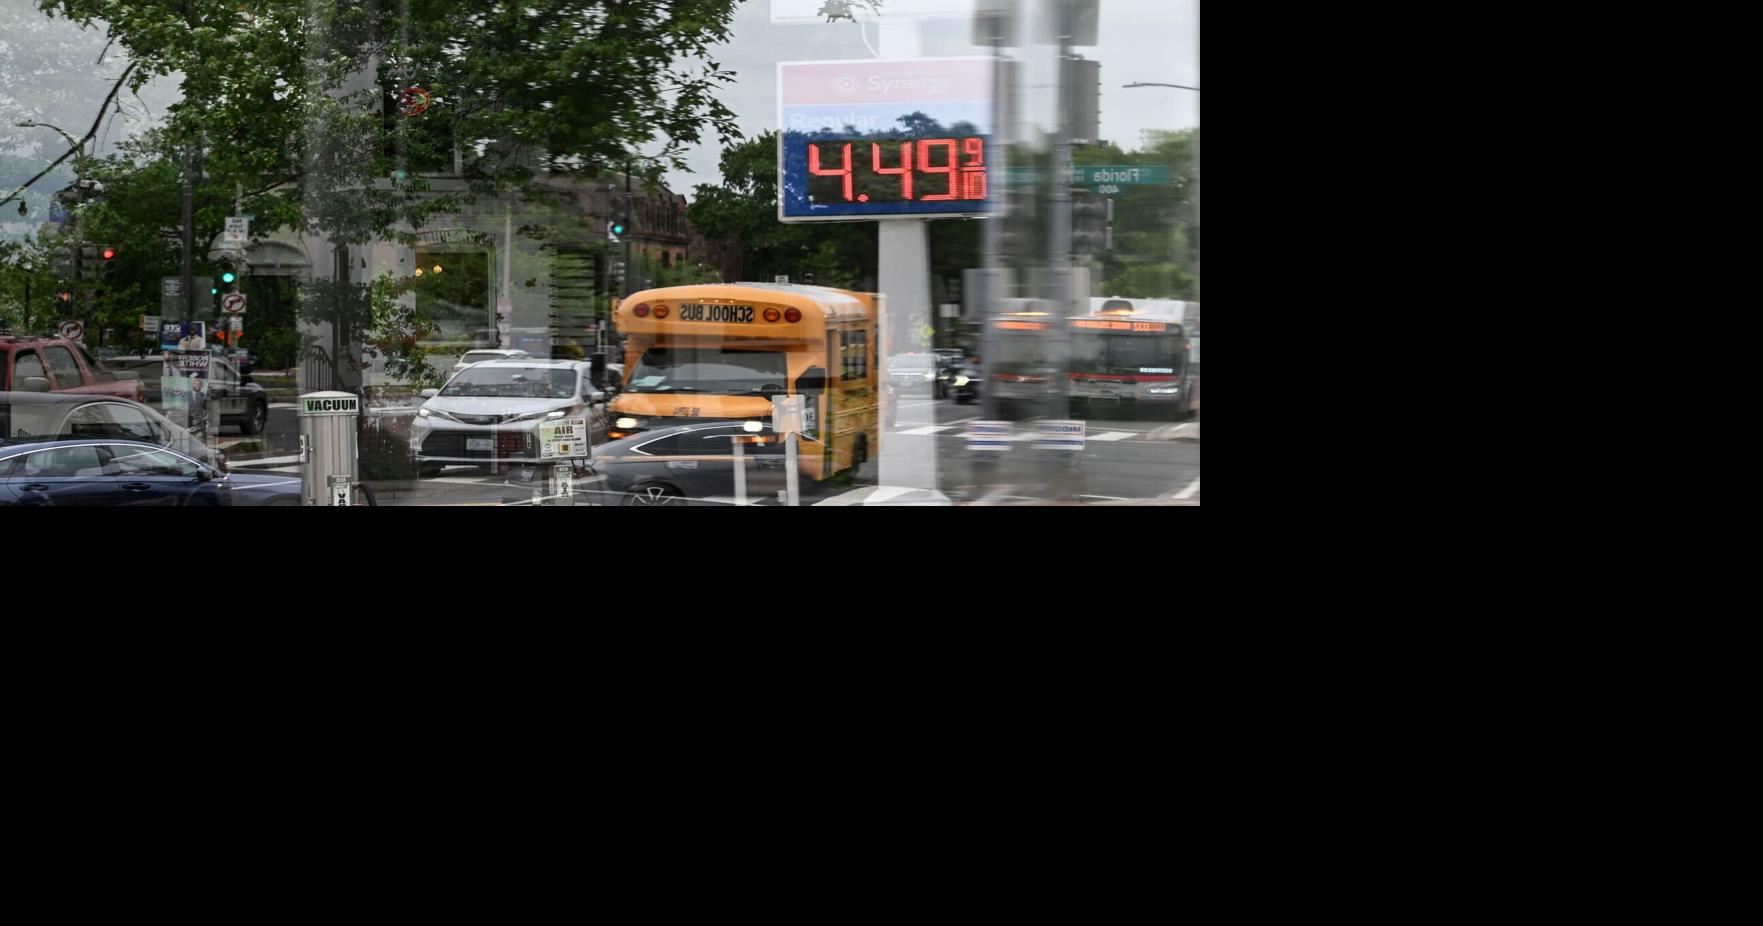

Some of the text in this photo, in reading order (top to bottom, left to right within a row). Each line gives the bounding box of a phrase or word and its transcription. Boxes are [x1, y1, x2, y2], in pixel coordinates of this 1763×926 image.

[868, 75, 951, 94] Synergy
[790, 112, 880, 130] Regular
[808, 138, 959, 202] 4.49
[306, 399, 357, 411] VACUUM
[554, 425, 574, 435] AIR
